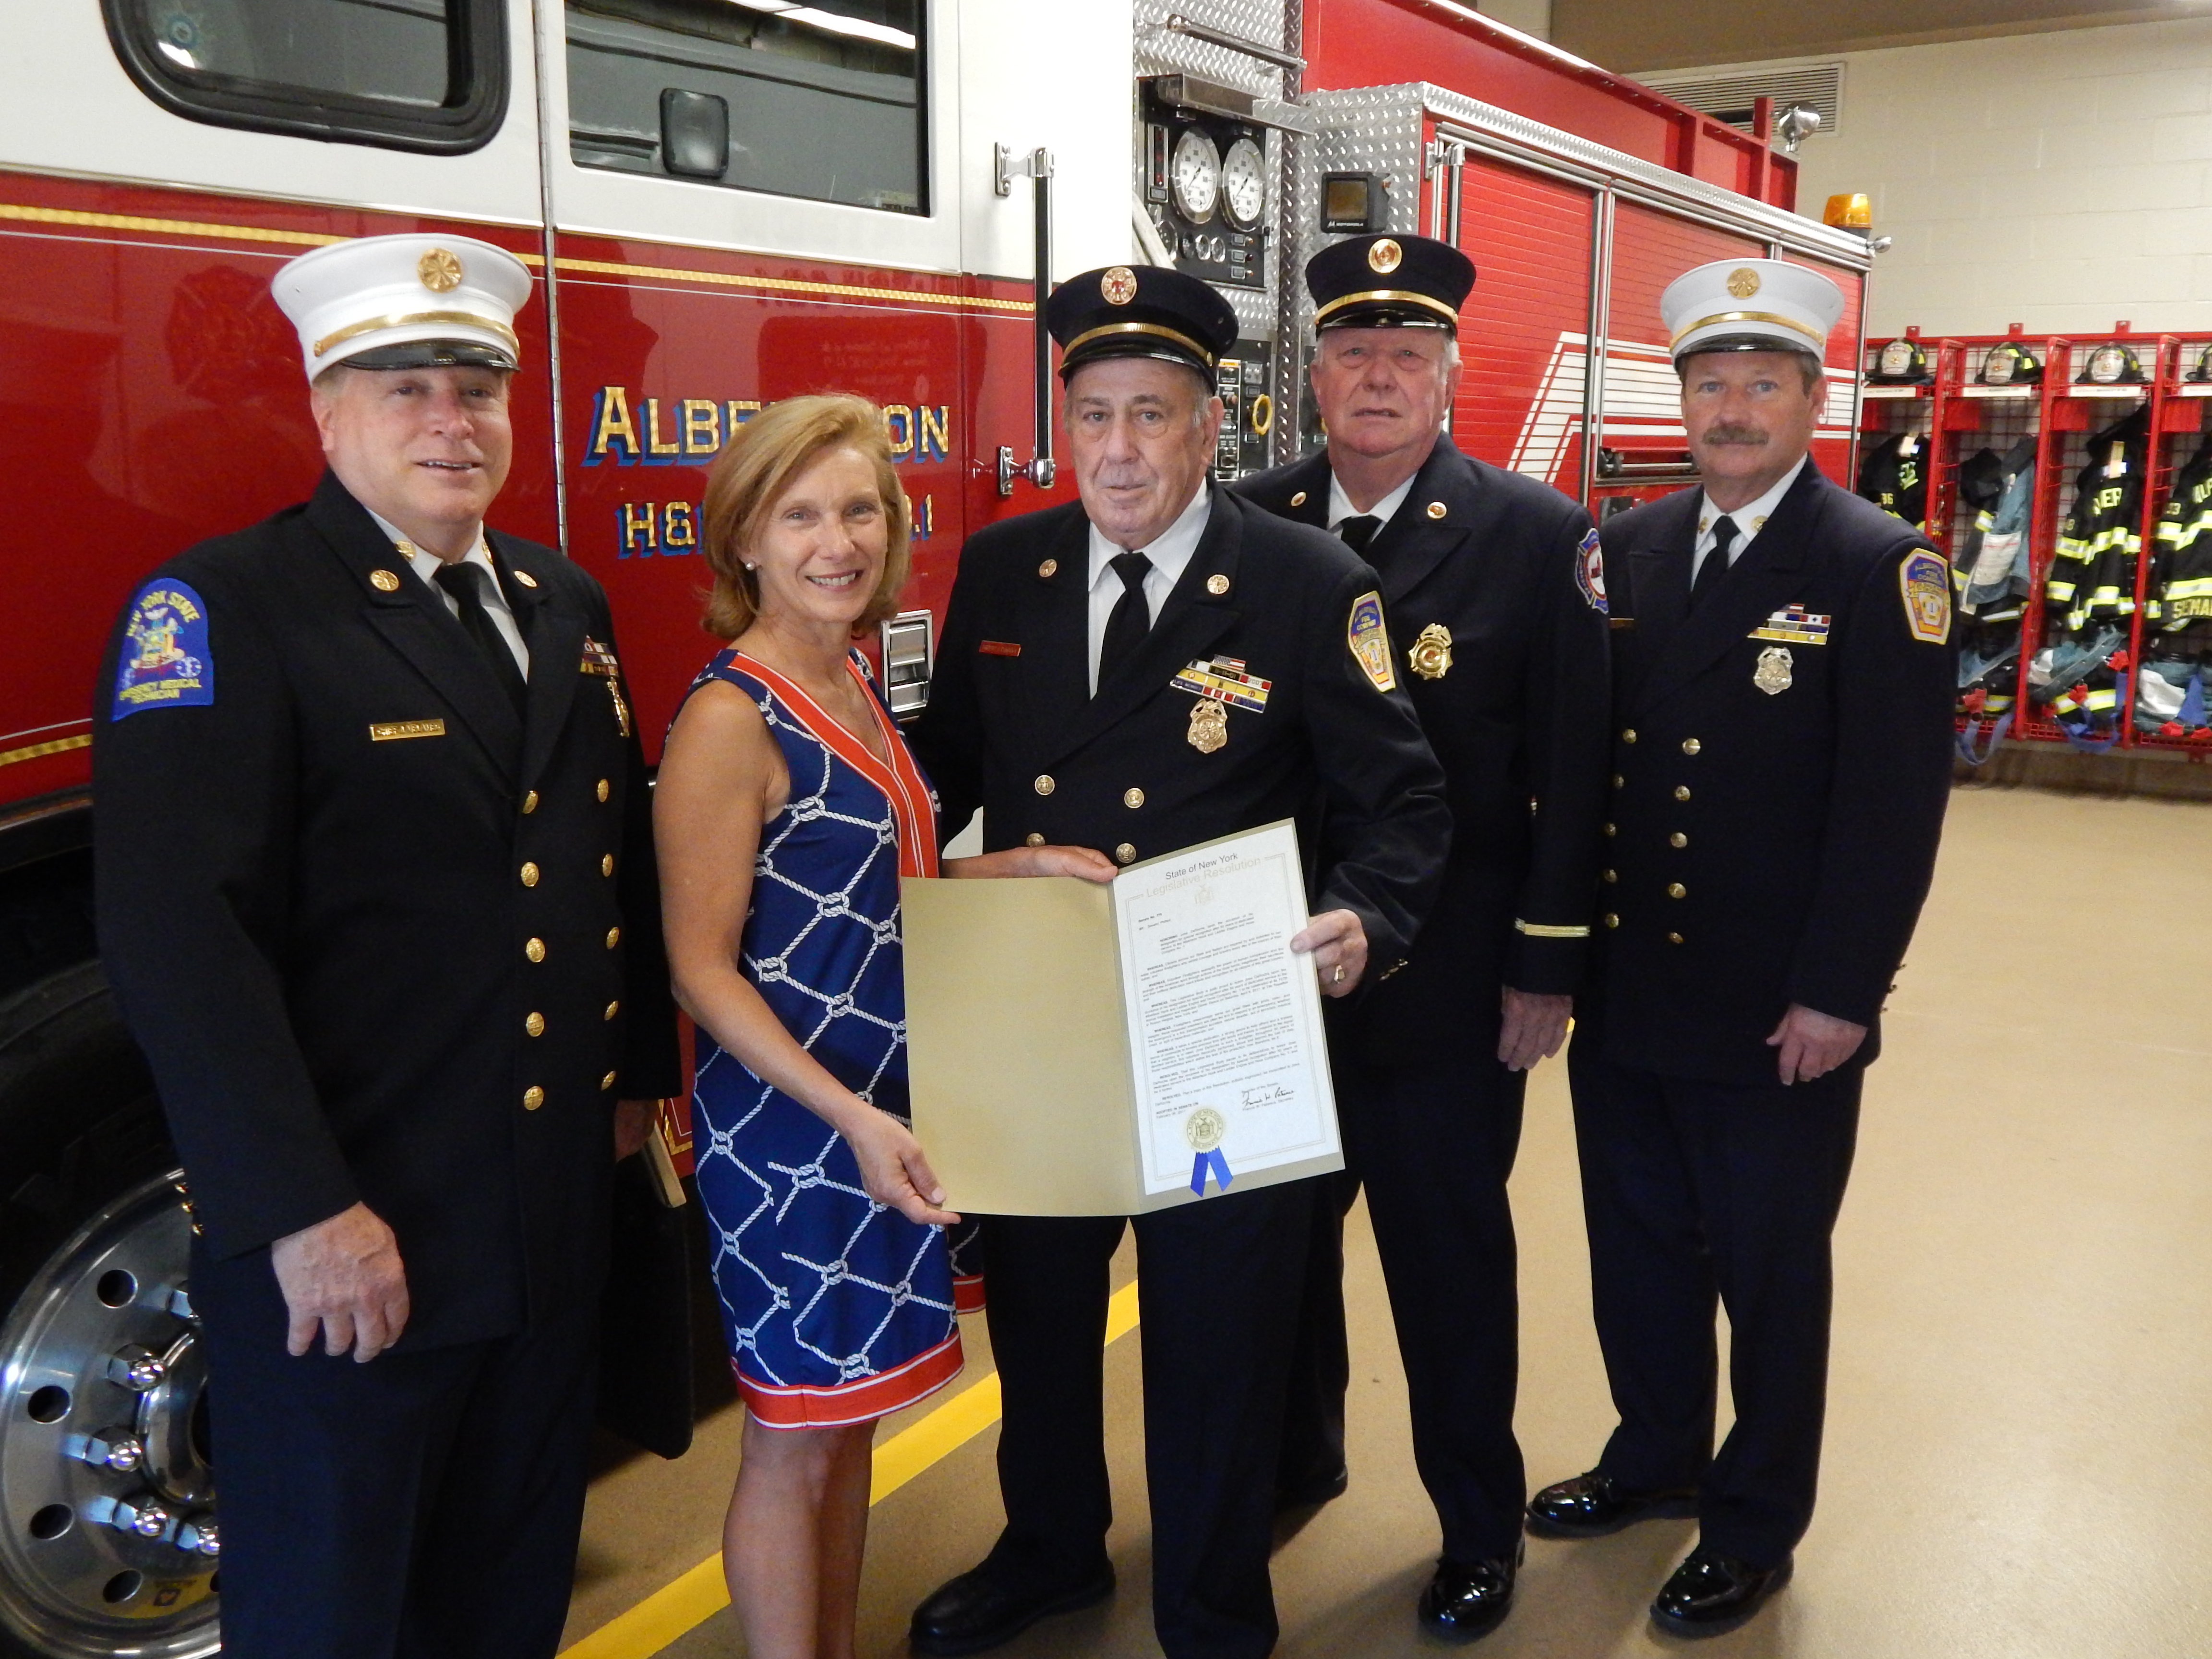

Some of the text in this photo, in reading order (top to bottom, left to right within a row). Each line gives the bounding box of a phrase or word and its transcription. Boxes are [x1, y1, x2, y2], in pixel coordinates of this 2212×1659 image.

[582, 386, 950, 465] ALBEON
[615, 501, 704, 559] H&
[1146, 858, 1261, 898] Legislative Resolution
[1166, 853, 1238, 880] State of New York
